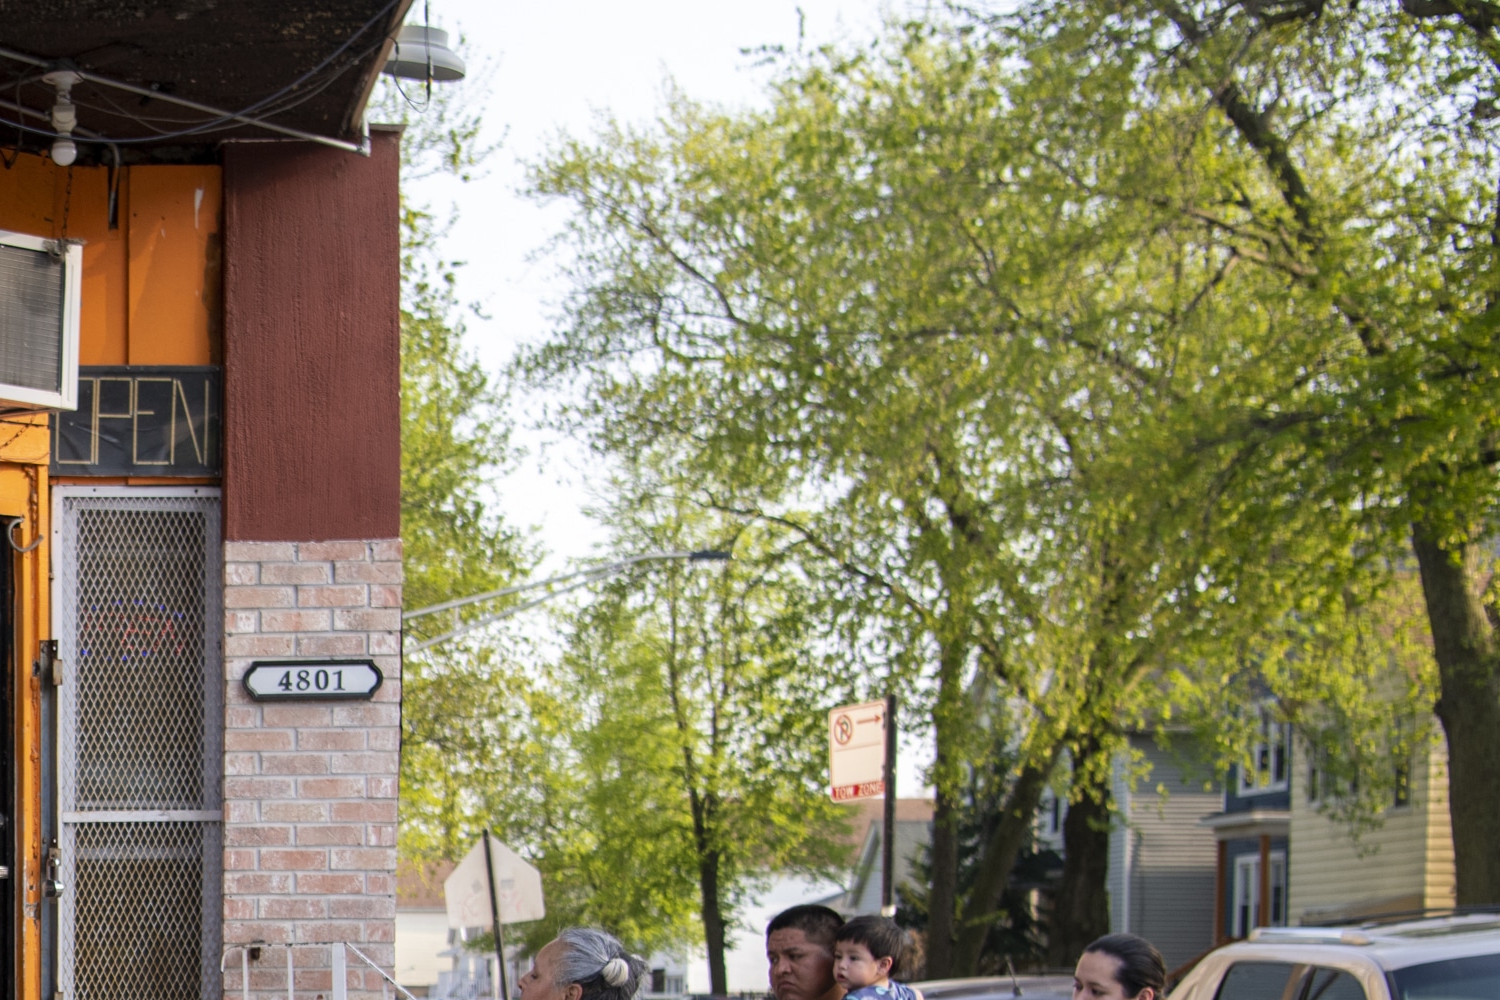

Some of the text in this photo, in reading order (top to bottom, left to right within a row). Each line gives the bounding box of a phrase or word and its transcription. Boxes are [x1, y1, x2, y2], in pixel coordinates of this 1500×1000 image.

[277, 669, 346, 692] 4801
[835, 781, 885, 800] TOW ZONE
